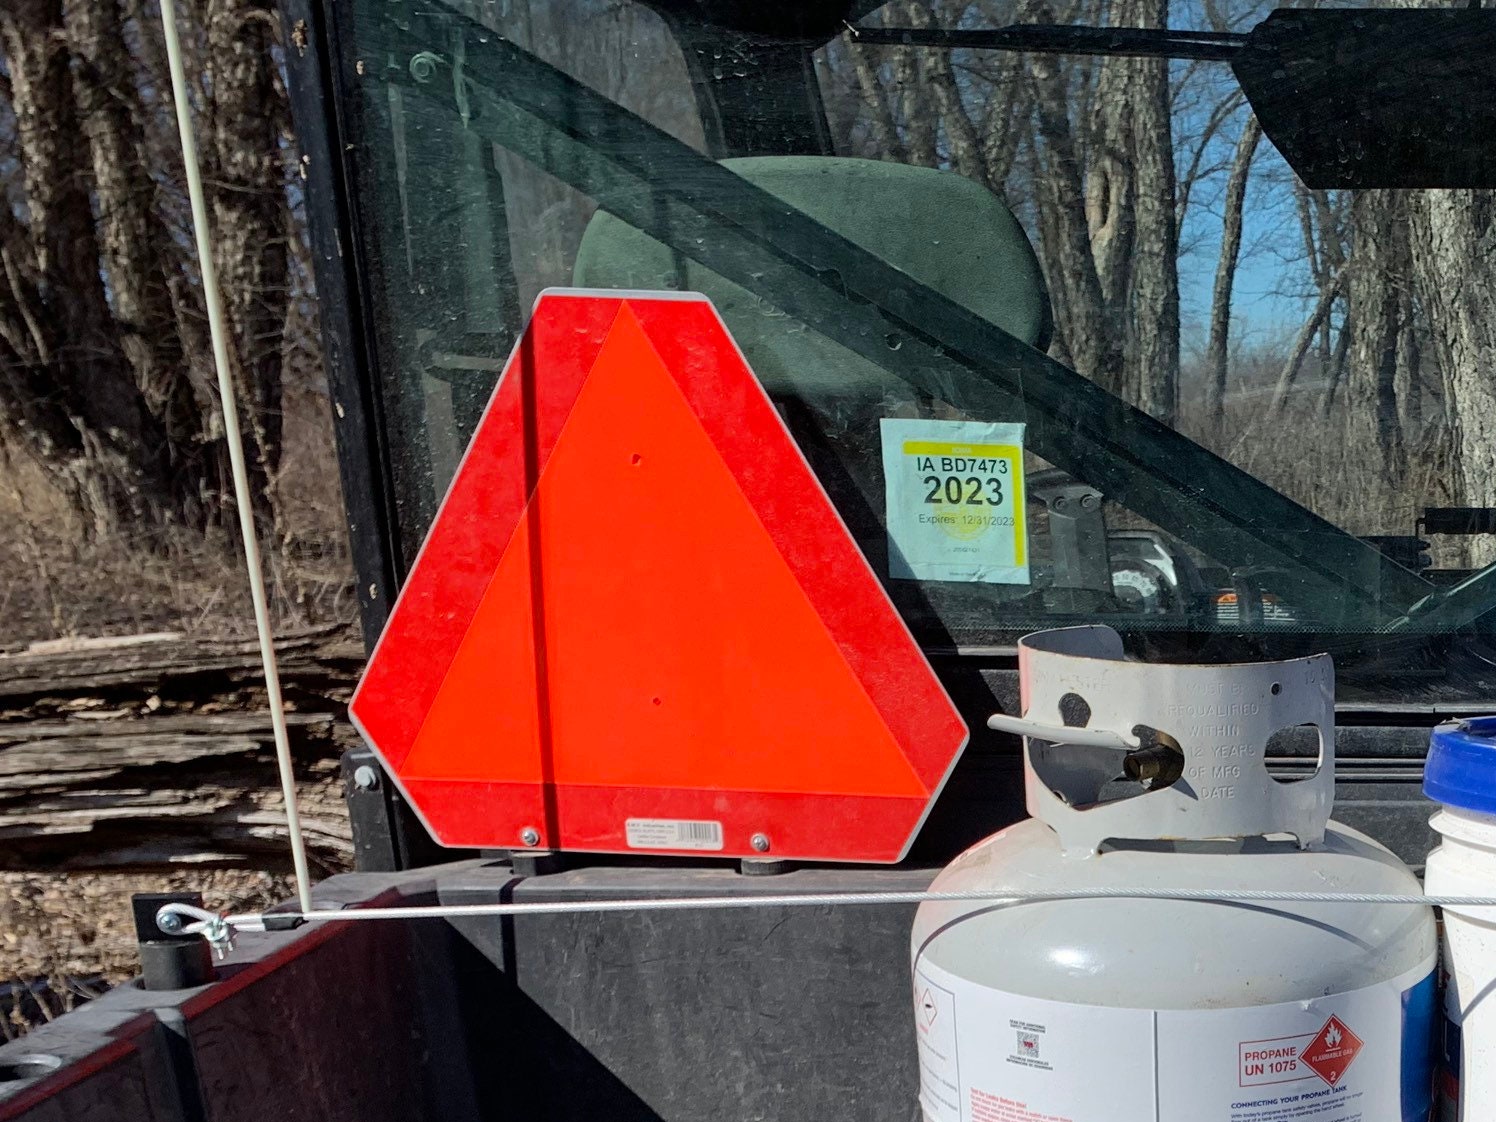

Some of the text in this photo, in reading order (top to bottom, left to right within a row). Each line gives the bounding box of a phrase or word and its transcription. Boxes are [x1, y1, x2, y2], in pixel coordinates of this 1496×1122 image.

[917, 457, 1008, 474] IA BD7473
[923, 475, 1004, 506] 2023
[962, 515, 1015, 527] 12/31/2023
[1168, 704, 1260, 717] REQUALIFIED
[1190, 725, 1240, 737] WITHIN
[1190, 745, 1256, 757] 12 YEARS
[1188, 767, 1241, 779] OF MFG
[1200, 787, 1235, 799] DATE
[1245, 1046, 1297, 1061] PROPANE
[1311, 1048, 1353, 1063] FLAMMABLE GAS
[1244, 1060, 1297, 1076] UN 1075
[1330, 1071, 1336, 1081] 2
[1231, 1085, 1347, 1109] CONNECTING YOUR PROPANE TANK
